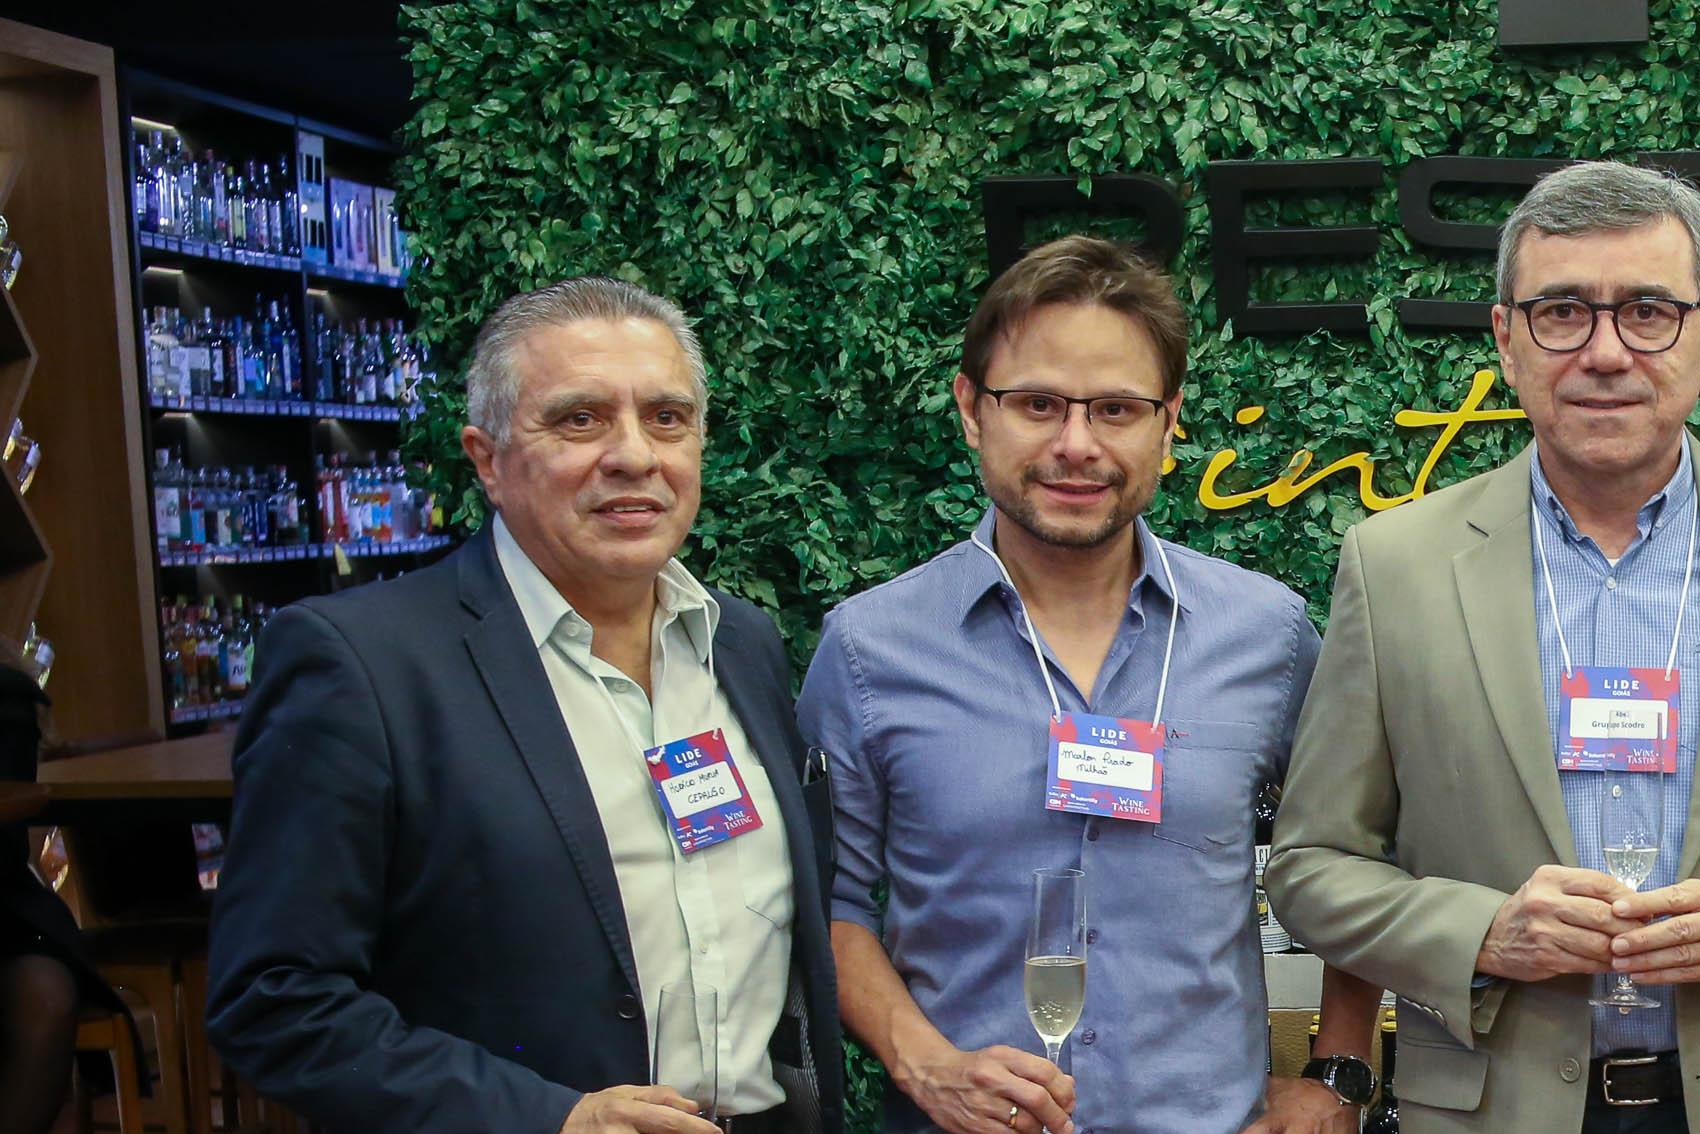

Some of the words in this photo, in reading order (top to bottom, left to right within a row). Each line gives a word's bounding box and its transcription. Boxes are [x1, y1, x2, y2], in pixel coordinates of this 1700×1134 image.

[1603, 679, 1640, 690] LIDE
[1091, 727, 1127, 741] LIDE
[674, 748, 702, 764] LIDE
[1111, 802, 1150, 815] TASTING
[1119, 796, 1144, 808] WINE
[725, 810, 746, 822] WINE
[723, 815, 753, 831] TASTING
